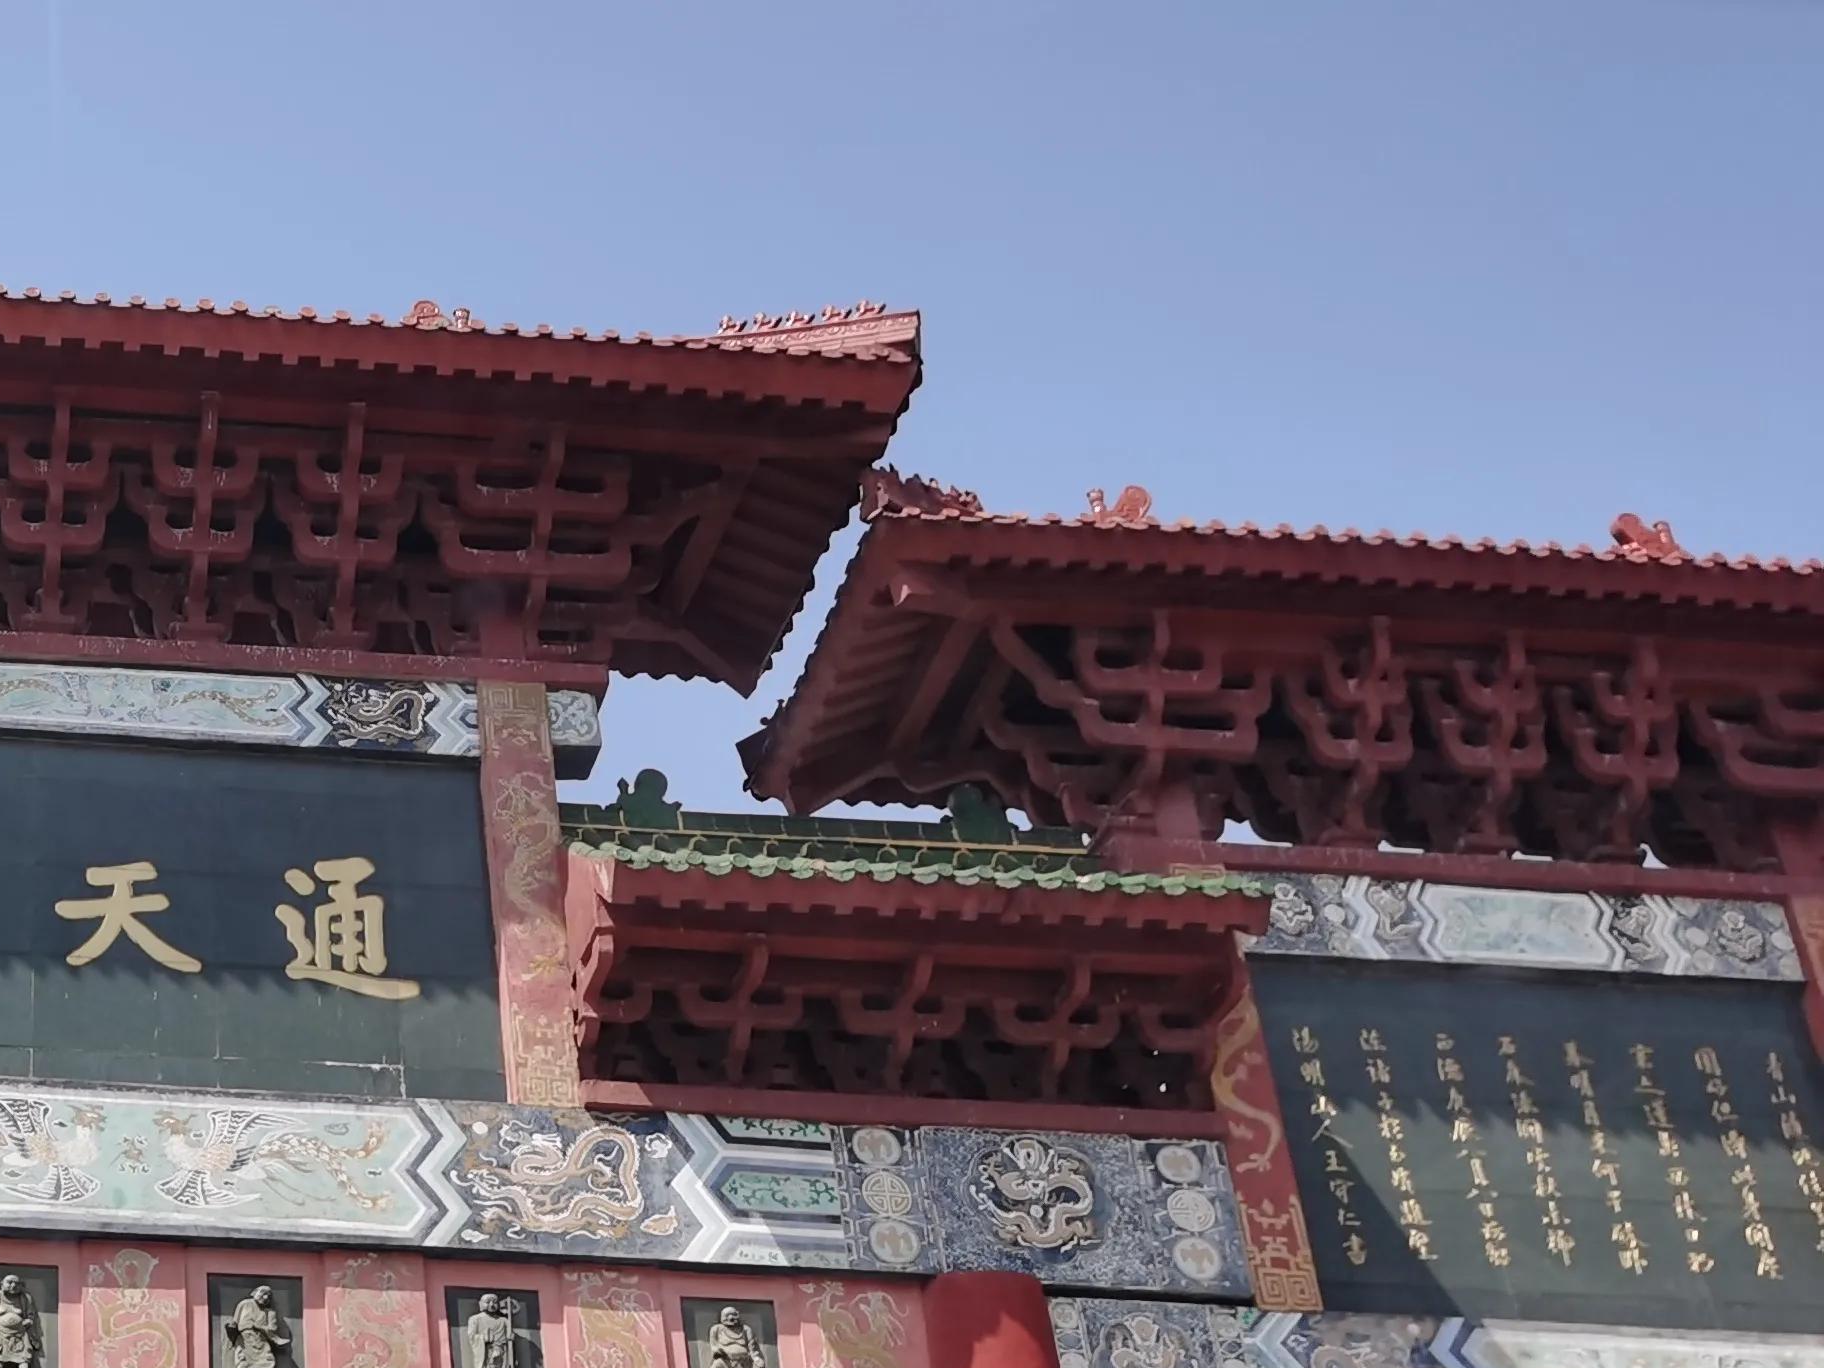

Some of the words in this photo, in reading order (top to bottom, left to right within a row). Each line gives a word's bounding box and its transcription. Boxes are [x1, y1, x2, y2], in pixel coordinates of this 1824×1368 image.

[1292, 1026, 1366, 1265] 陽明山人王守仁書
